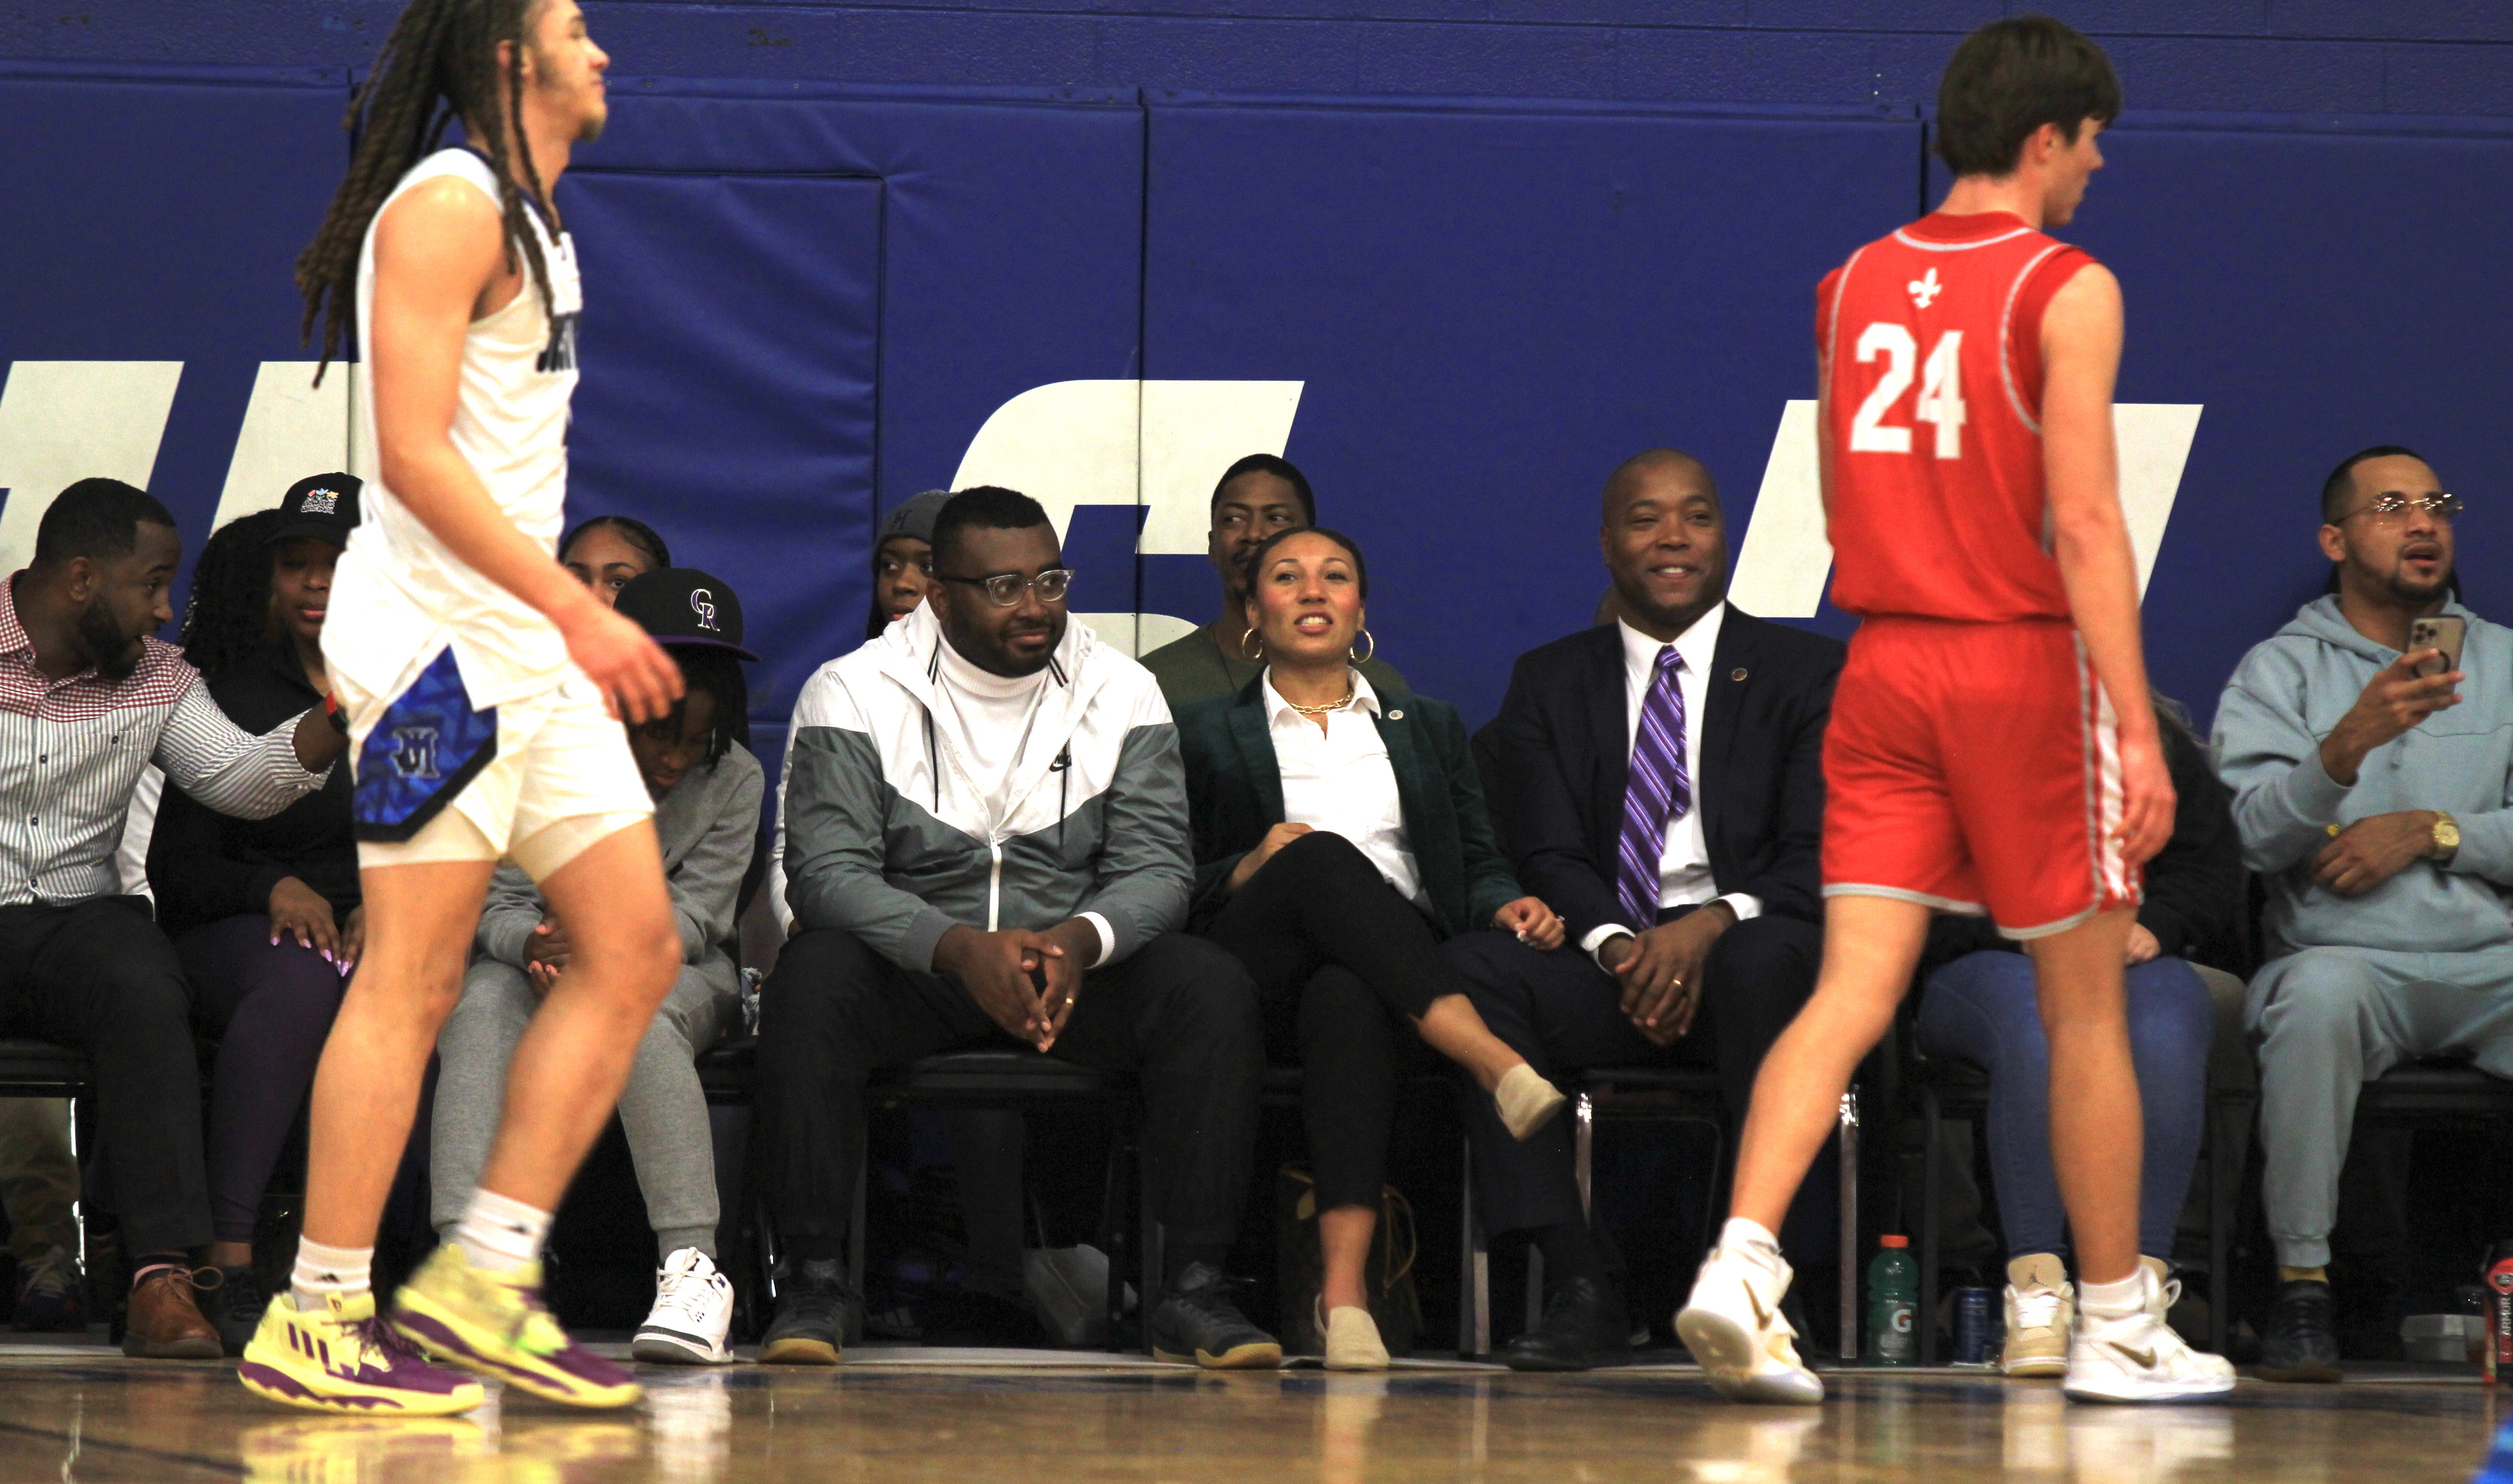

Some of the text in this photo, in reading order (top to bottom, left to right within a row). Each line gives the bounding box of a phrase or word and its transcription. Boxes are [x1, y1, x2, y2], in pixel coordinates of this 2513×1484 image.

[1850, 321, 1967, 459] 24
[1892, 1309, 1912, 1333] G
[2500, 1297, 2512, 1336] ARMOR
